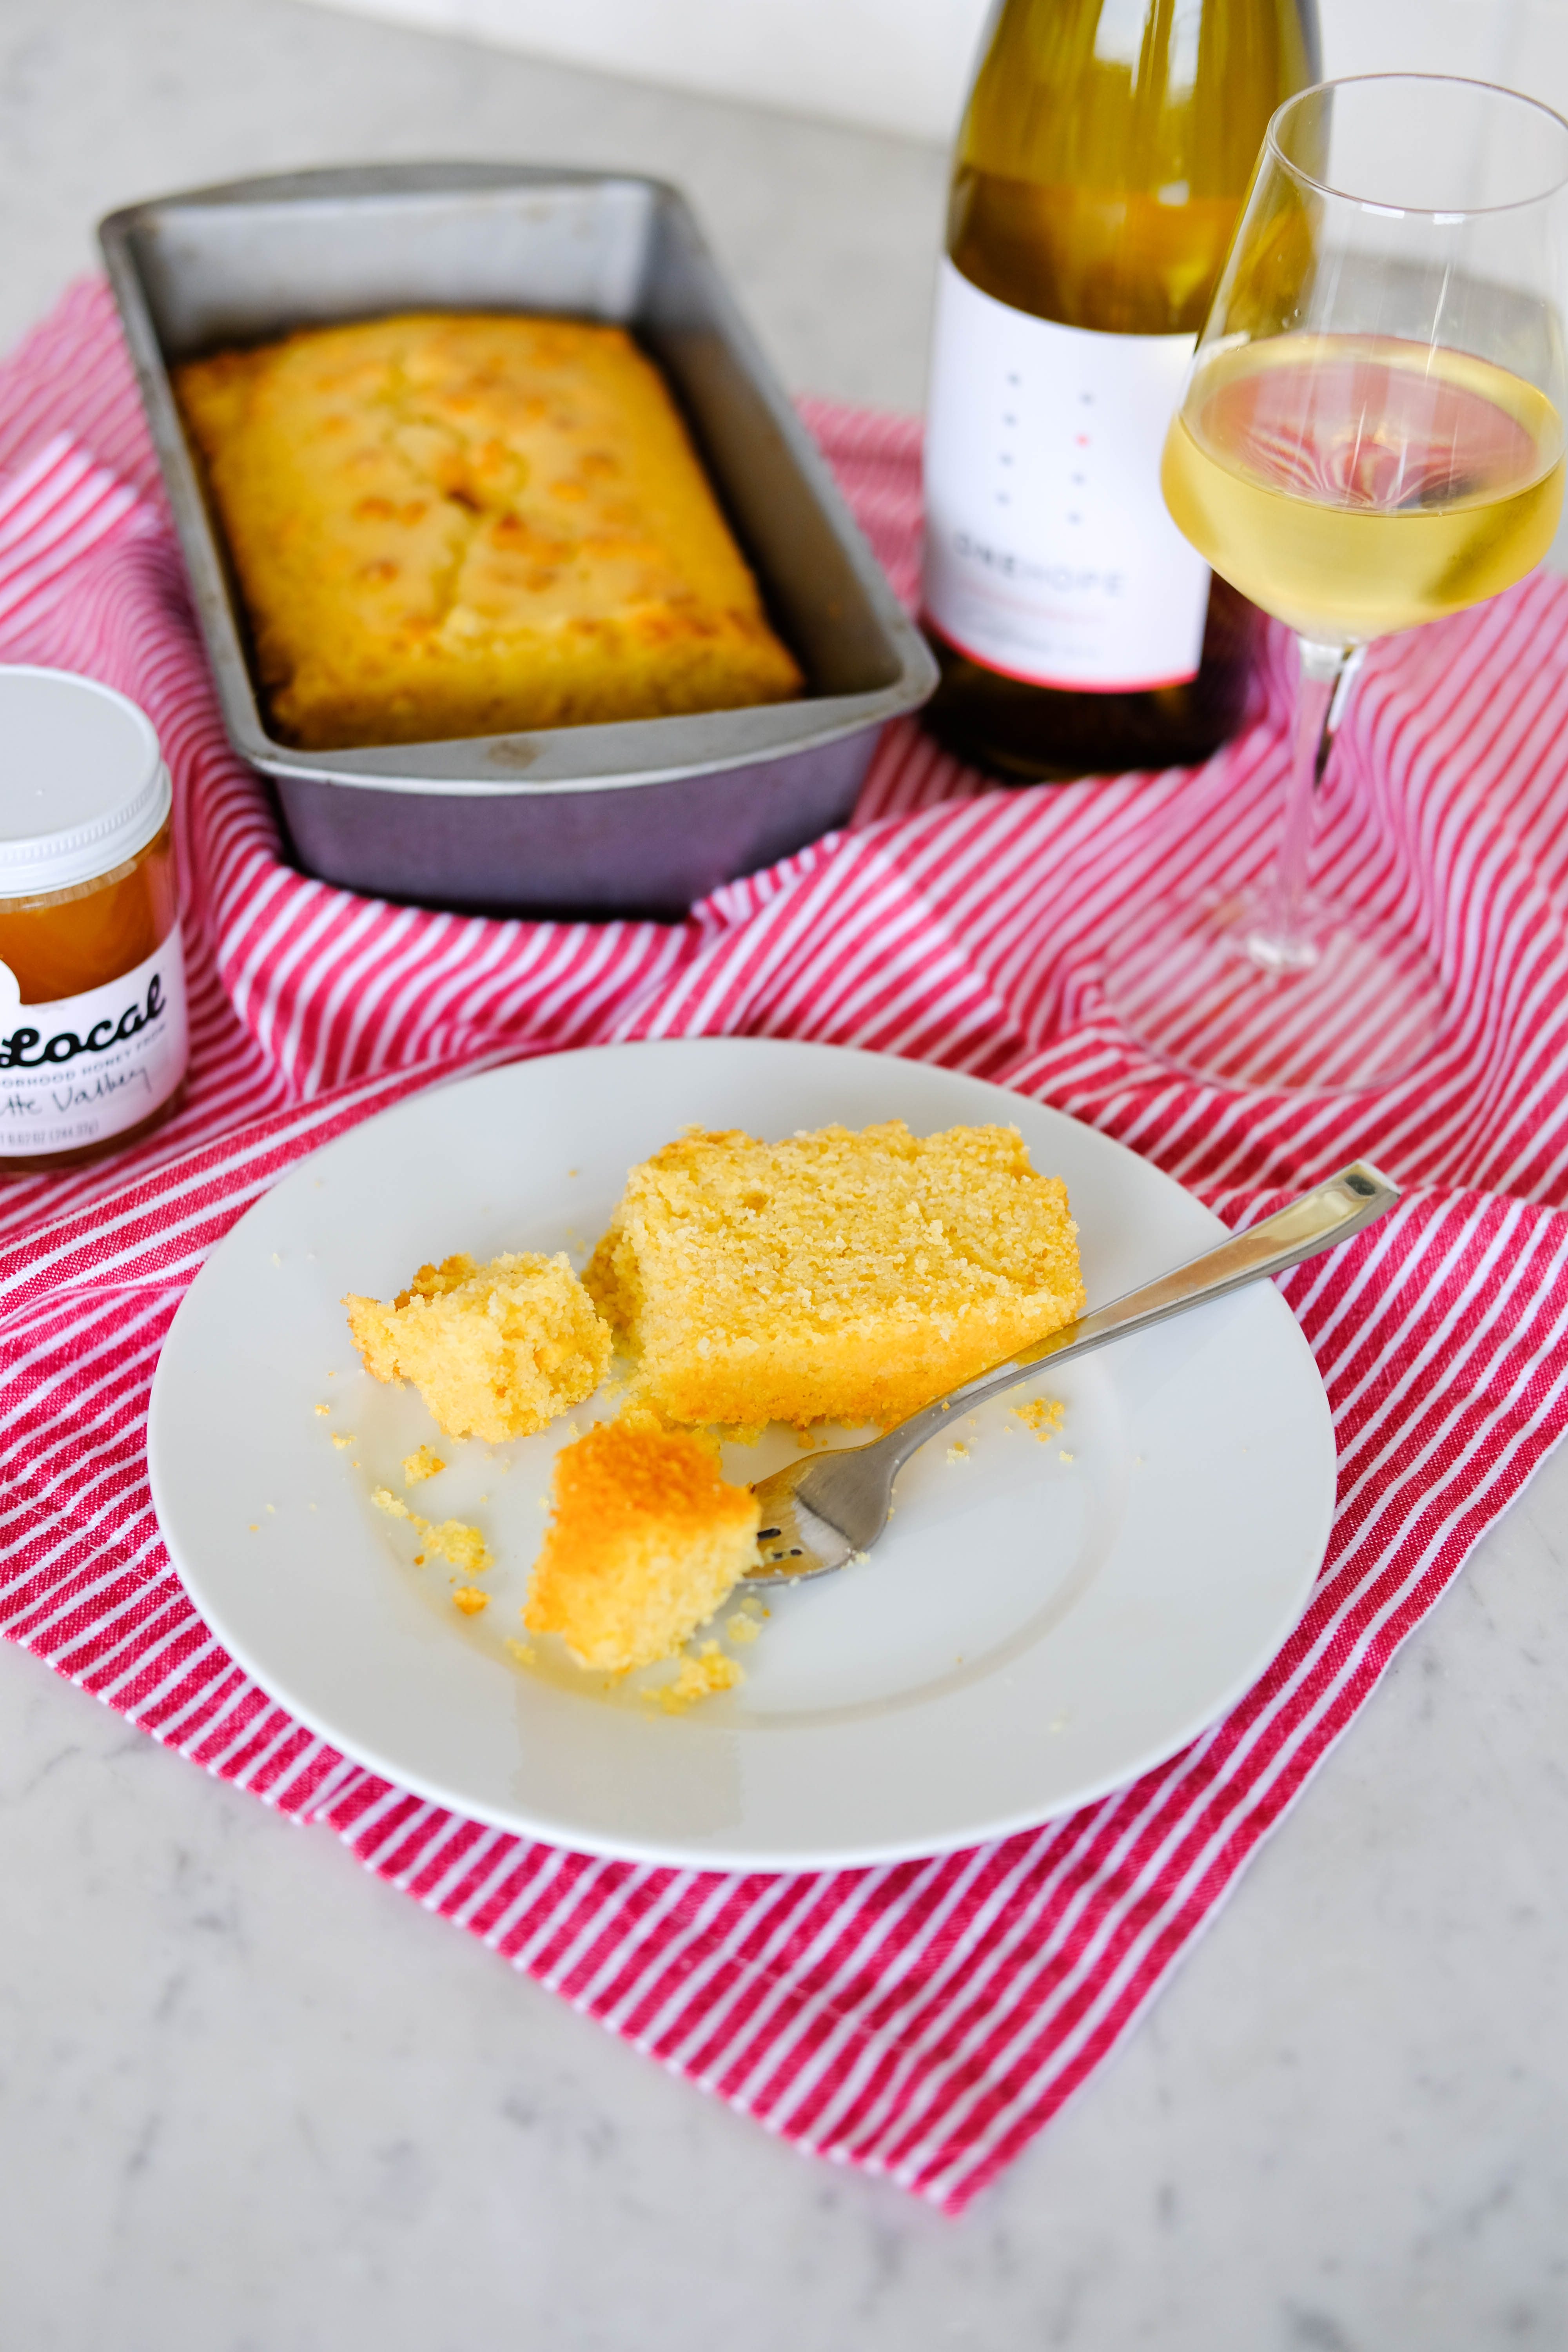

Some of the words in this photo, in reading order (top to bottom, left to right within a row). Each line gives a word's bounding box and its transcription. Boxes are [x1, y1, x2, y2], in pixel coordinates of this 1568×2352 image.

[0, 974, 165, 1068] Local
[0, 1069, 76, 1089] ORHOOD
[82, 1049, 131, 1076] HONEY
